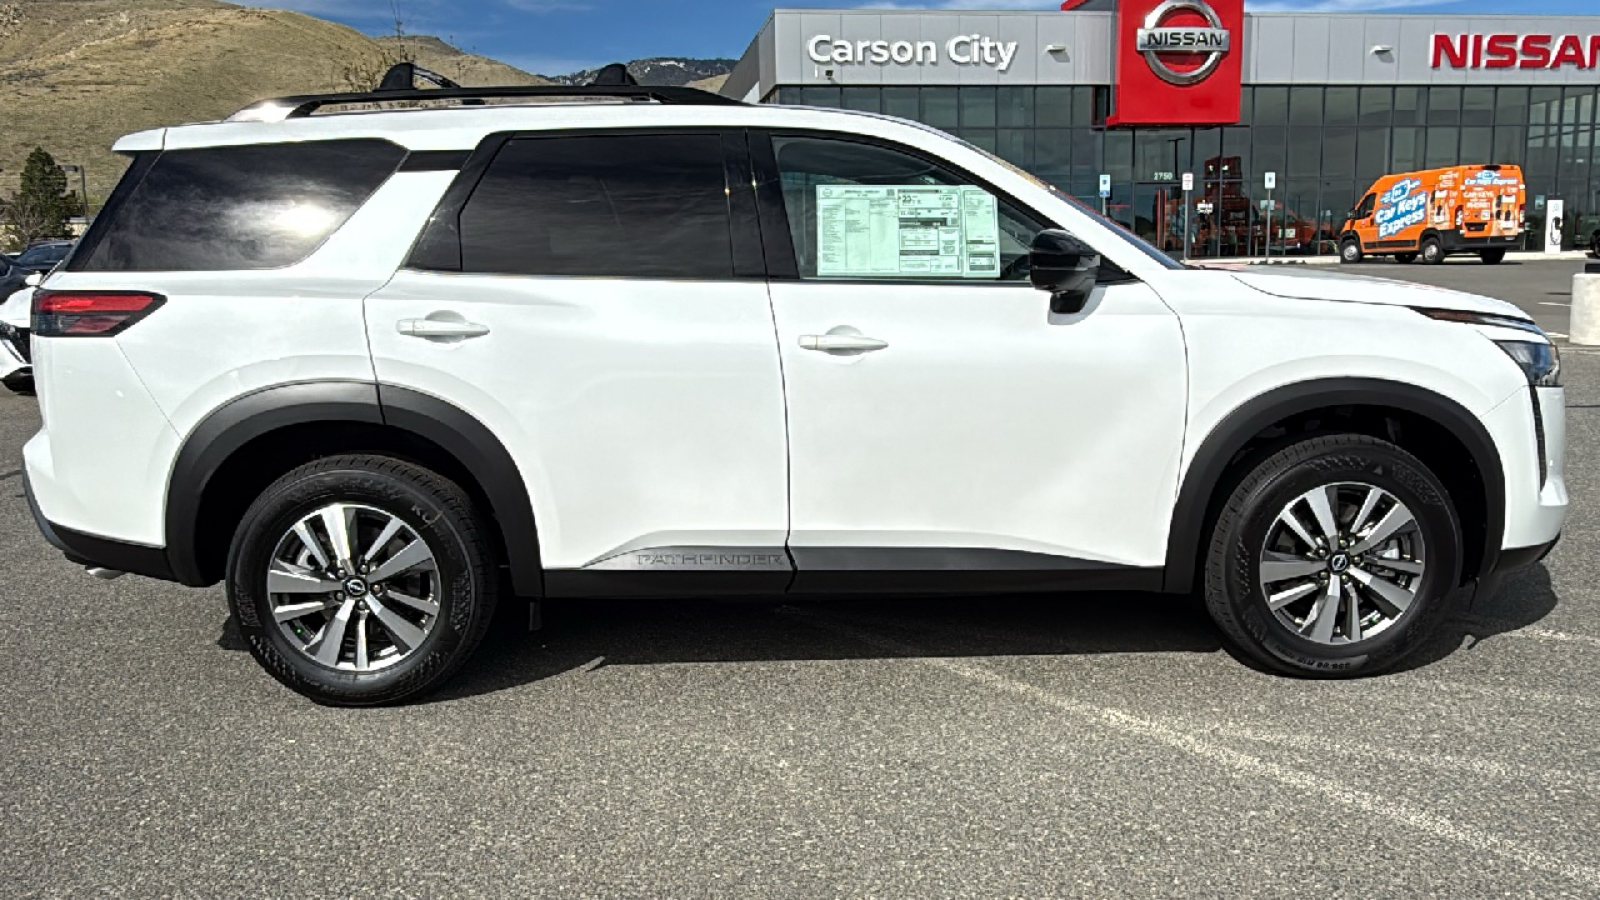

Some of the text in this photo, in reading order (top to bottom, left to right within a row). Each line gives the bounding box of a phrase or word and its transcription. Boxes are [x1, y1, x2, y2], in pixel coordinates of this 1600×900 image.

[807, 33, 1018, 71] Carson City
[1146, 31, 1223, 47] NISSAN
[1375, 191, 1426, 225] Car Keys
[1379, 208, 1425, 238] Express
[637, 553, 784, 565] PATHFINDER
